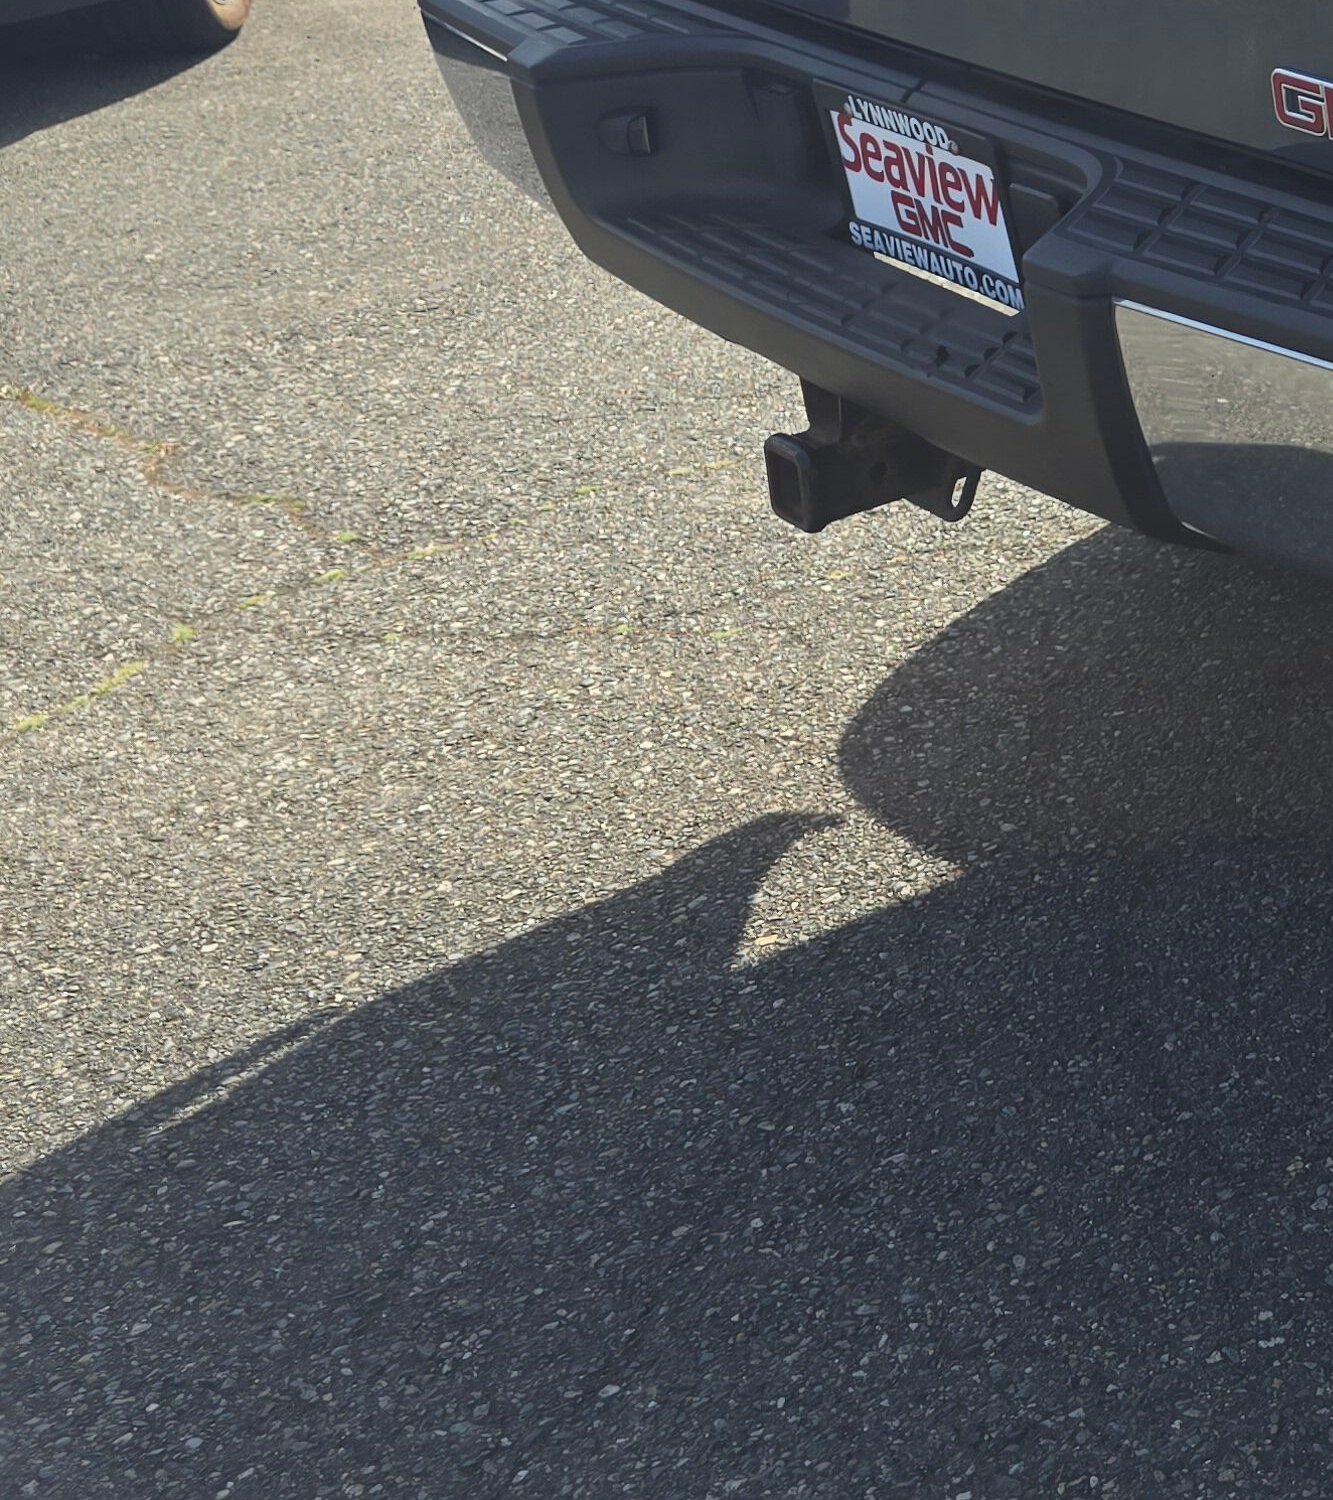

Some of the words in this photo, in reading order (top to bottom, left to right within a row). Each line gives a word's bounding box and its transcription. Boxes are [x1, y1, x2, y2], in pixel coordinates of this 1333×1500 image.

[848, 95, 951, 151] LYNNWOOD
[837, 113, 1001, 226] Seaview
[891, 190, 975, 258] GMC
[848, 221, 1025, 309] SEAVIEWAUTO.COM
